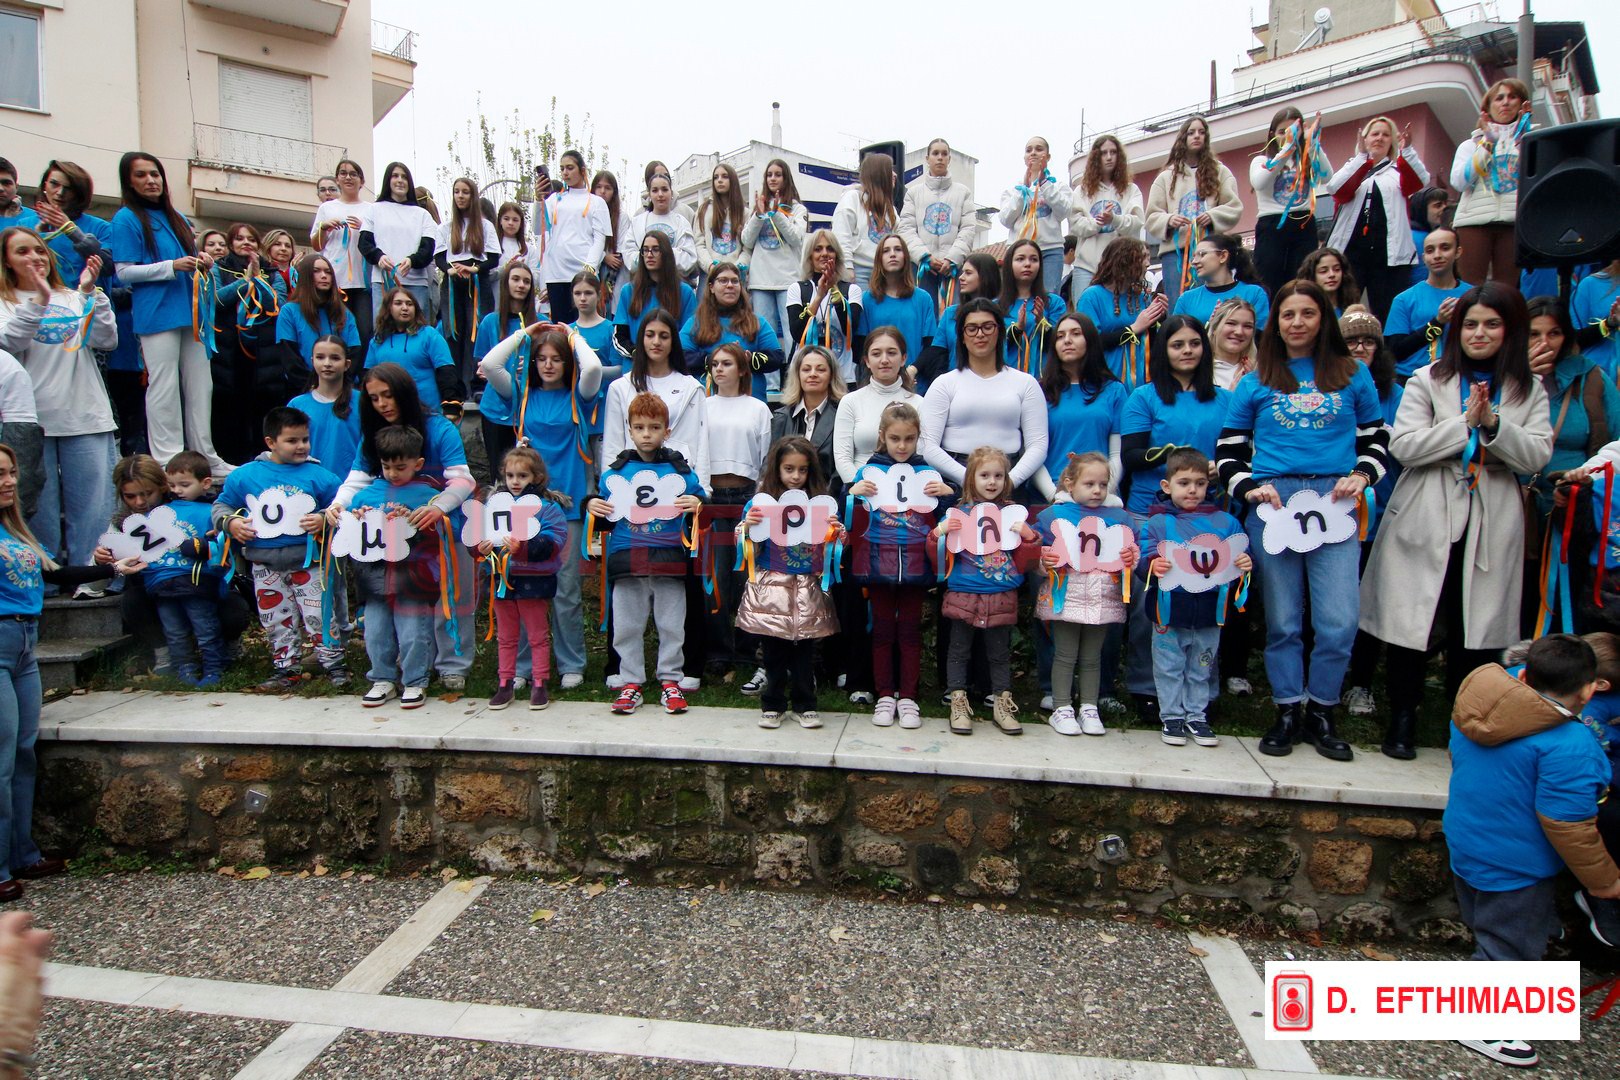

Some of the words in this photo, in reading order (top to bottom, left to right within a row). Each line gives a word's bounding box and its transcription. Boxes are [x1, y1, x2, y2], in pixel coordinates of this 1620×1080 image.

[635, 485, 659, 509] ε
[129, 524, 167, 552] Σ
[360, 521, 388, 557] μ
